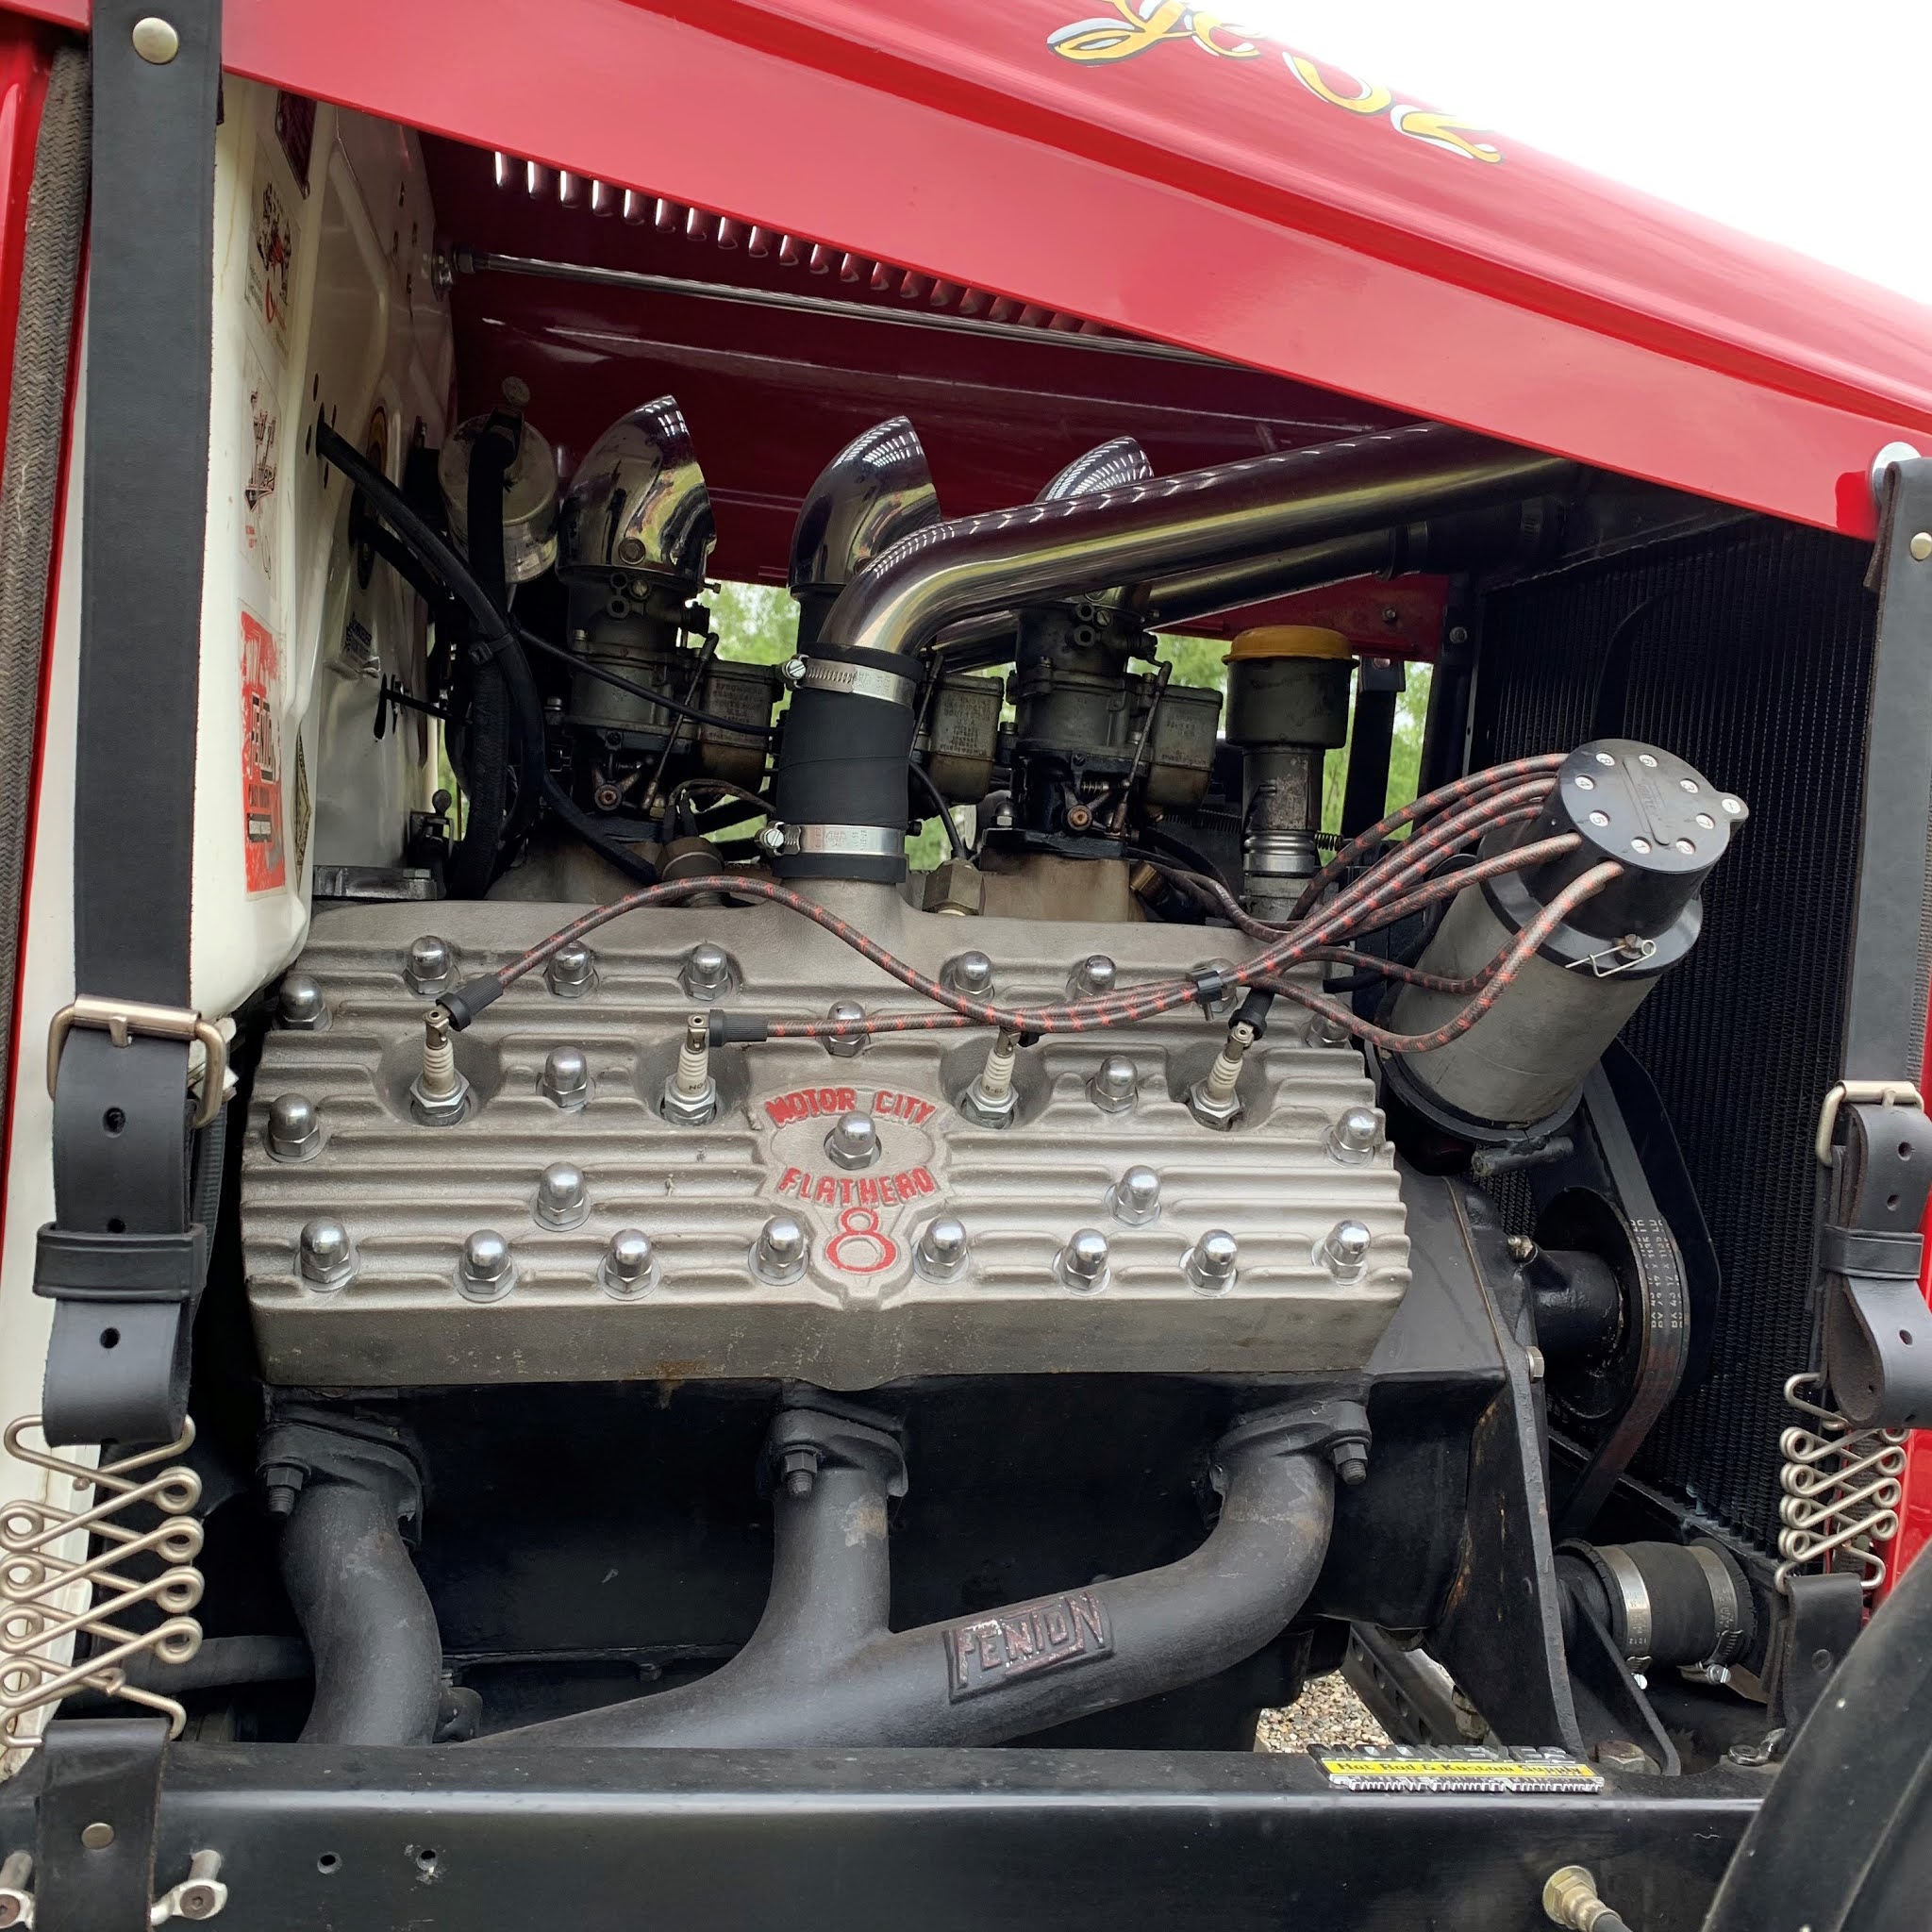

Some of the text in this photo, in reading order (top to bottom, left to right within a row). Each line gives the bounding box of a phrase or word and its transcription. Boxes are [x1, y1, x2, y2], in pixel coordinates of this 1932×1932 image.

[765, 1087, 937, 1128] MOTOR CITY
[777, 1167, 937, 1207] FLATHEAD
[825, 1207, 898, 1274] 8
[954, 1591, 1106, 1689] FENTON
[1337, 1762, 1374, 1771] Hot
[1379, 1762, 1416, 1771] Rod
[1441, 1763, 1514, 1772] Kustom
[1518, 1765, 1582, 1774] Supply
